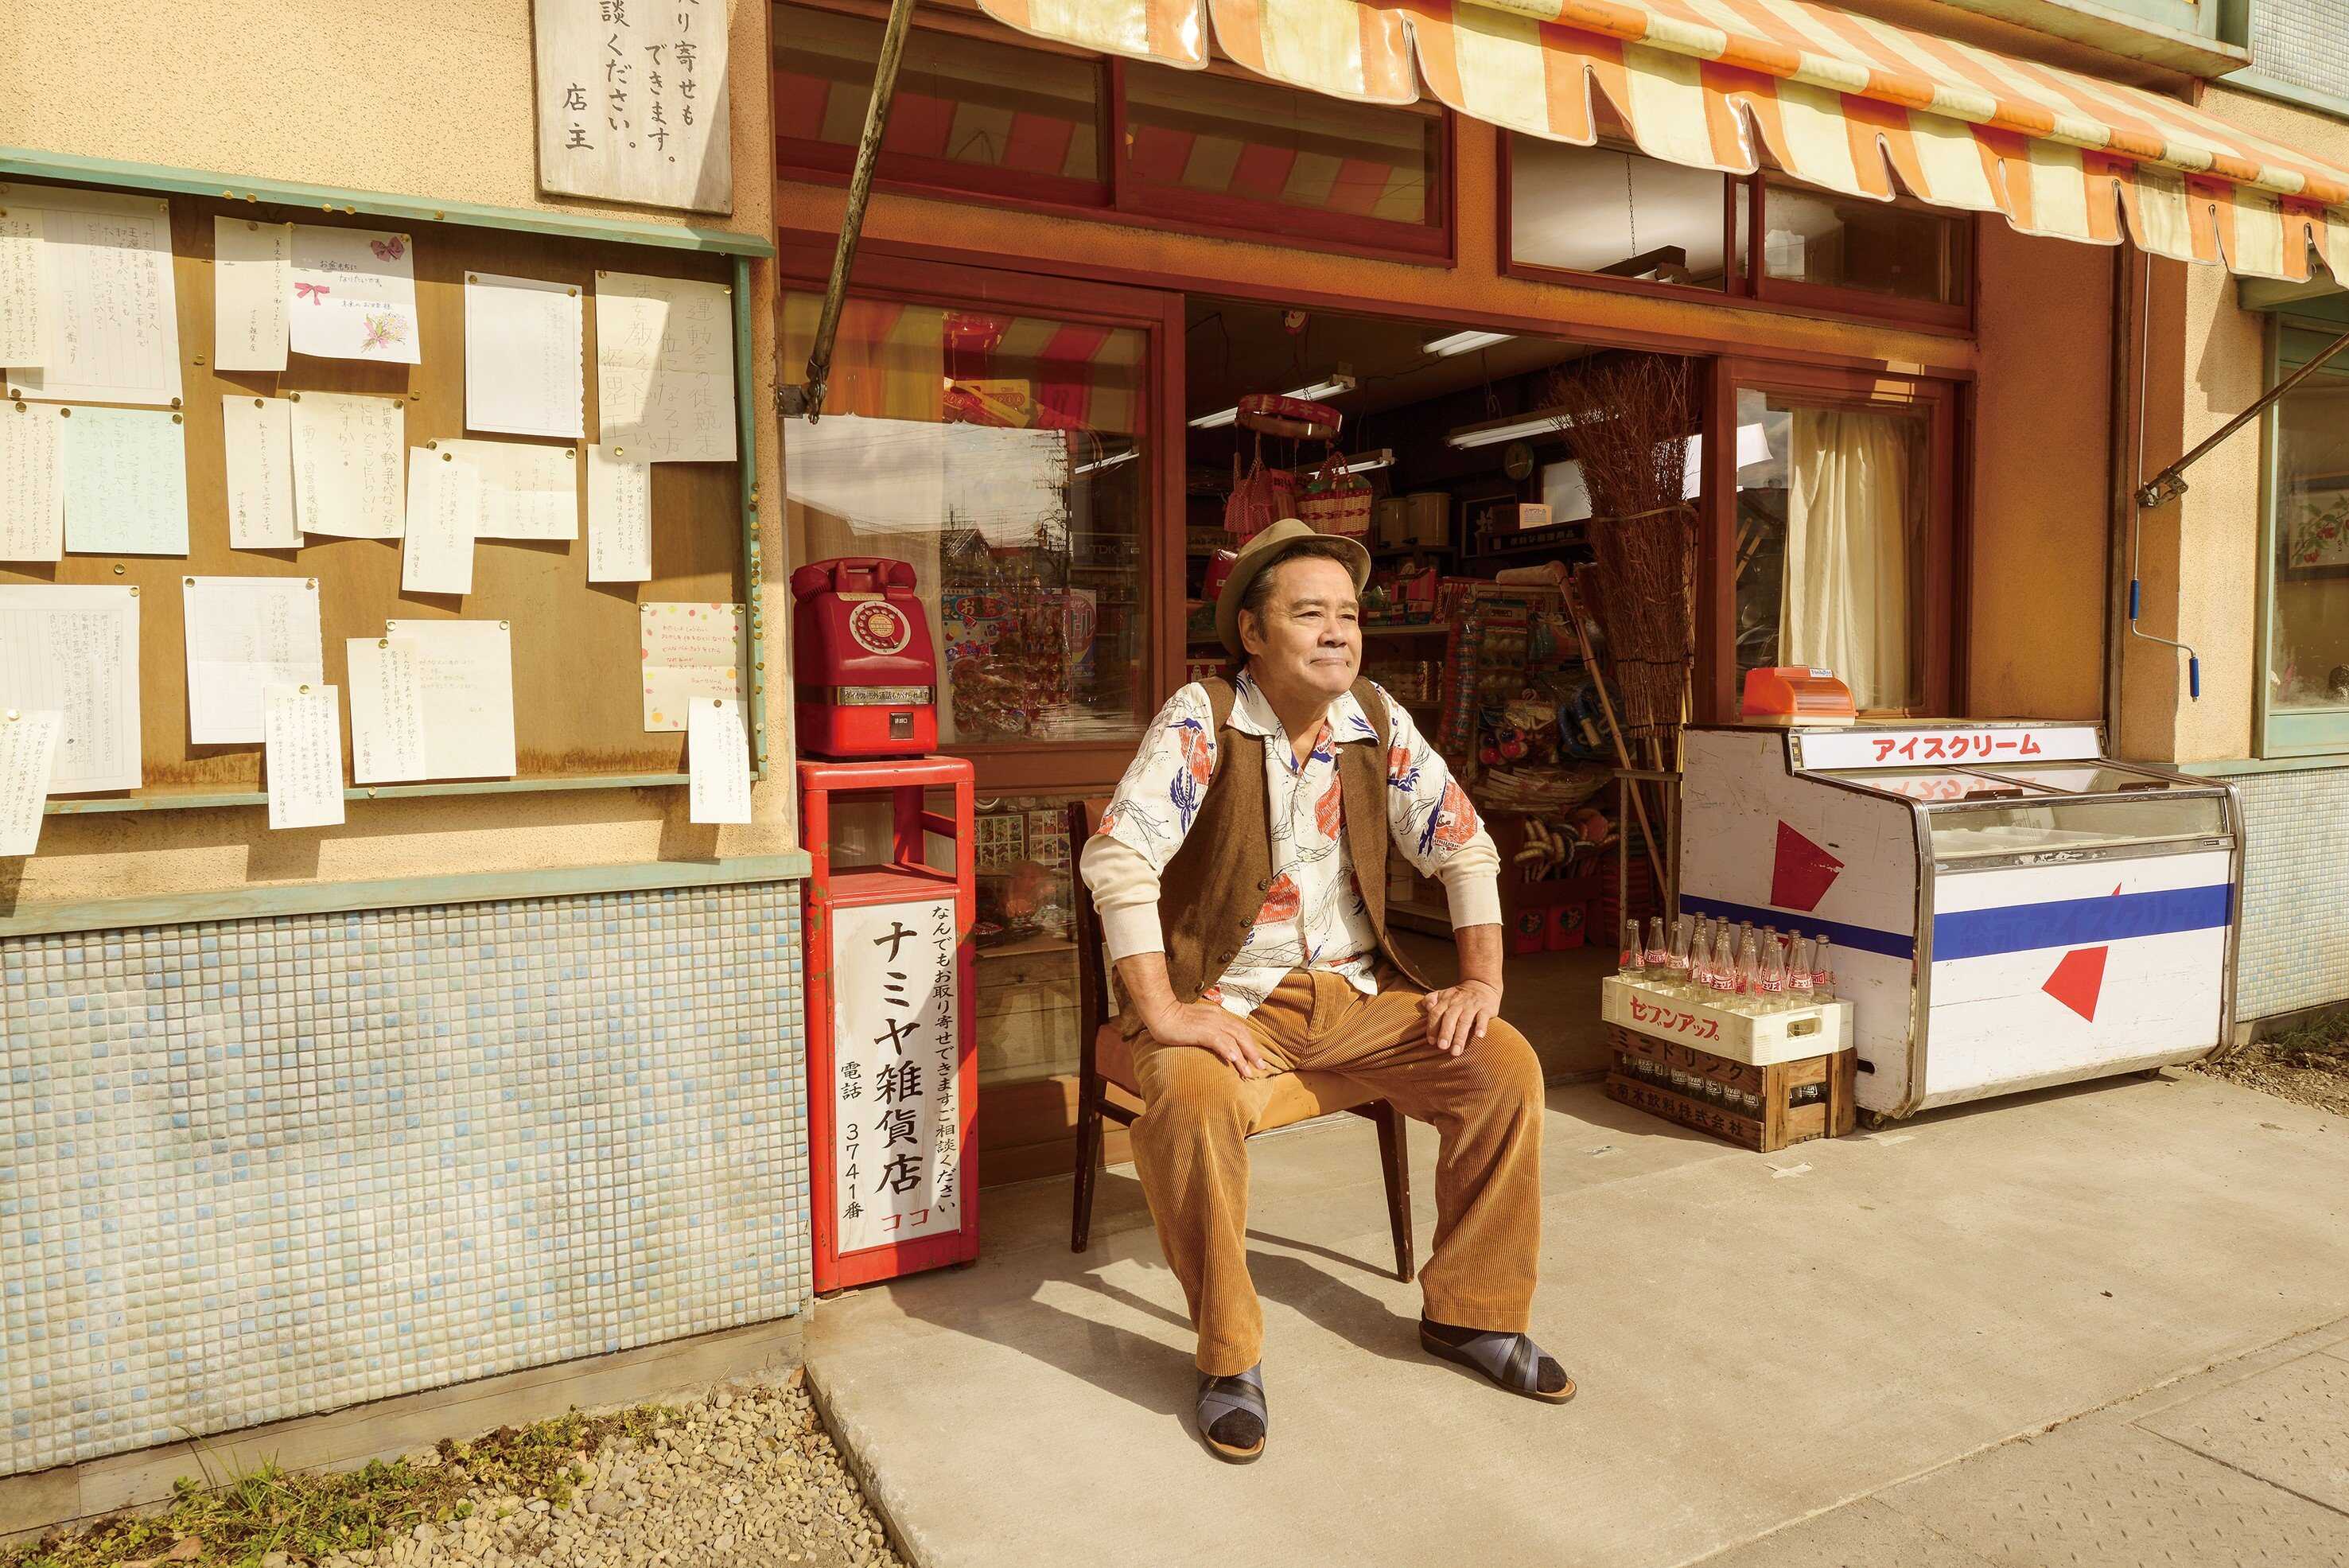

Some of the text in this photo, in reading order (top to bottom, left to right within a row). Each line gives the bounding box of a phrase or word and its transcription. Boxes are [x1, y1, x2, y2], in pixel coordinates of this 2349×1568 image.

[644, 43, 675, 163] できます。
[675, 0, 699, 126] り寄せも
[562, 83, 594, 150] 店主
[685, 297, 725, 457] 運動会の徒競走
[1872, 733, 2042, 762] アイスクリーム
[873, 920, 924, 1196] ナミヤ雑貨店
[932, 905, 956, 1212] なんでもお取り寄せできますご相談ください
[1617, 1030, 1743, 1080] ミニドリンク
[1630, 994, 1720, 1041] セブンアップ
[840, 1060, 863, 1101] 電話
